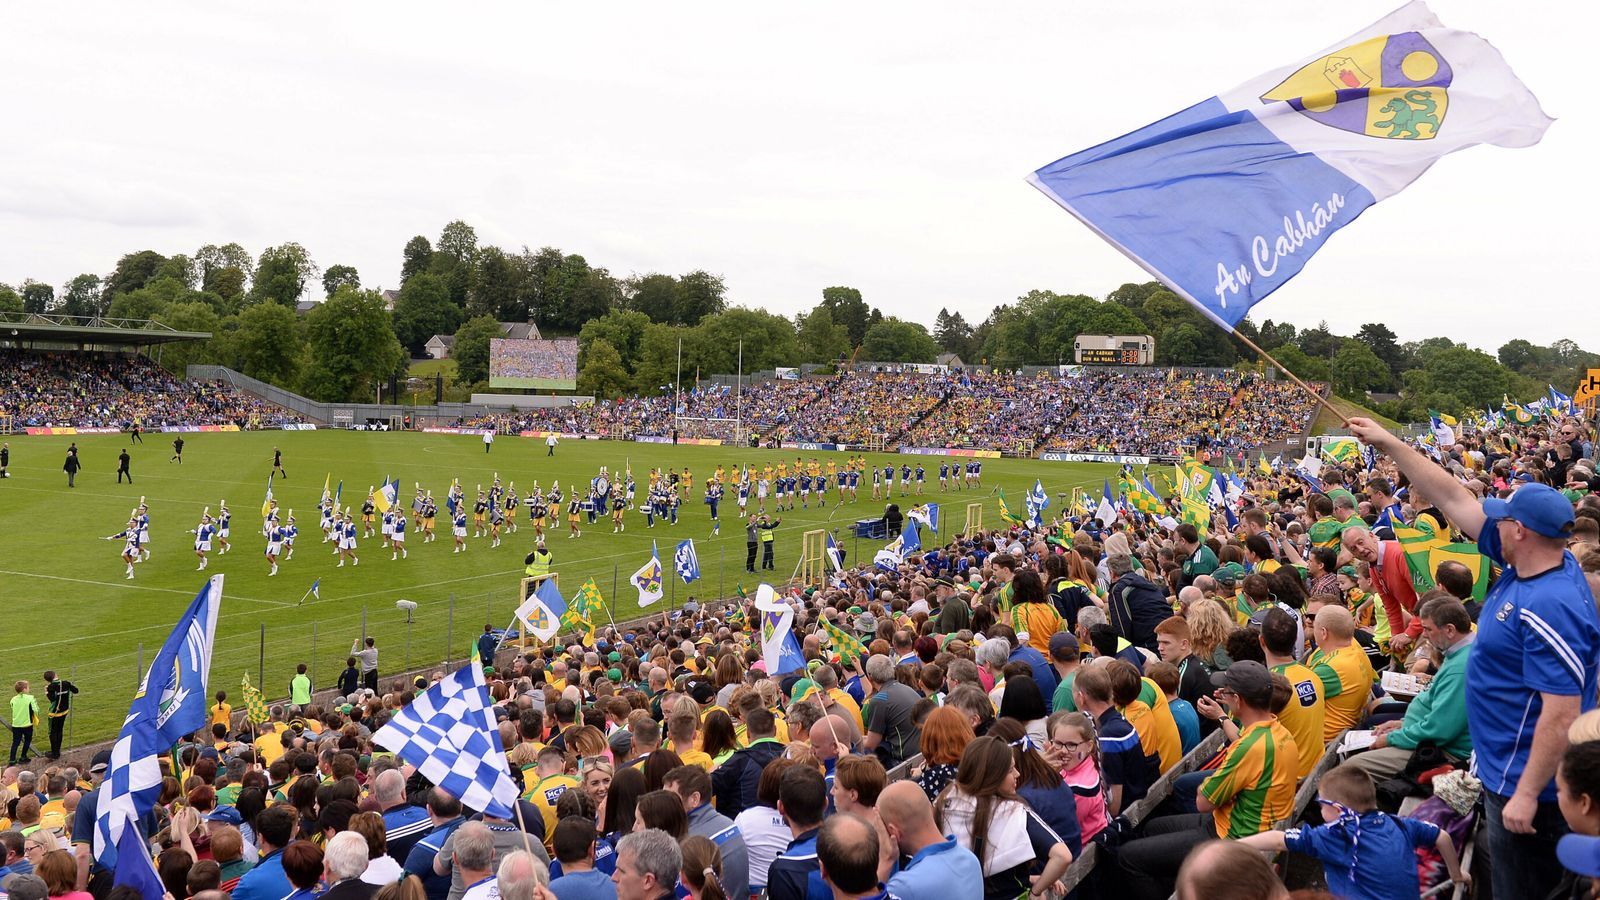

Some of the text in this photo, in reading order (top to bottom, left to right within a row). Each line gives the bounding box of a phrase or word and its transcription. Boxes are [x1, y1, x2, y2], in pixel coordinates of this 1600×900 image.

[1215, 192, 1345, 309] An Cabhán
[1043, 453, 1062, 461] GAA
[1097, 455, 1116, 463] GAA
[1298, 684, 1313, 696] MCR
